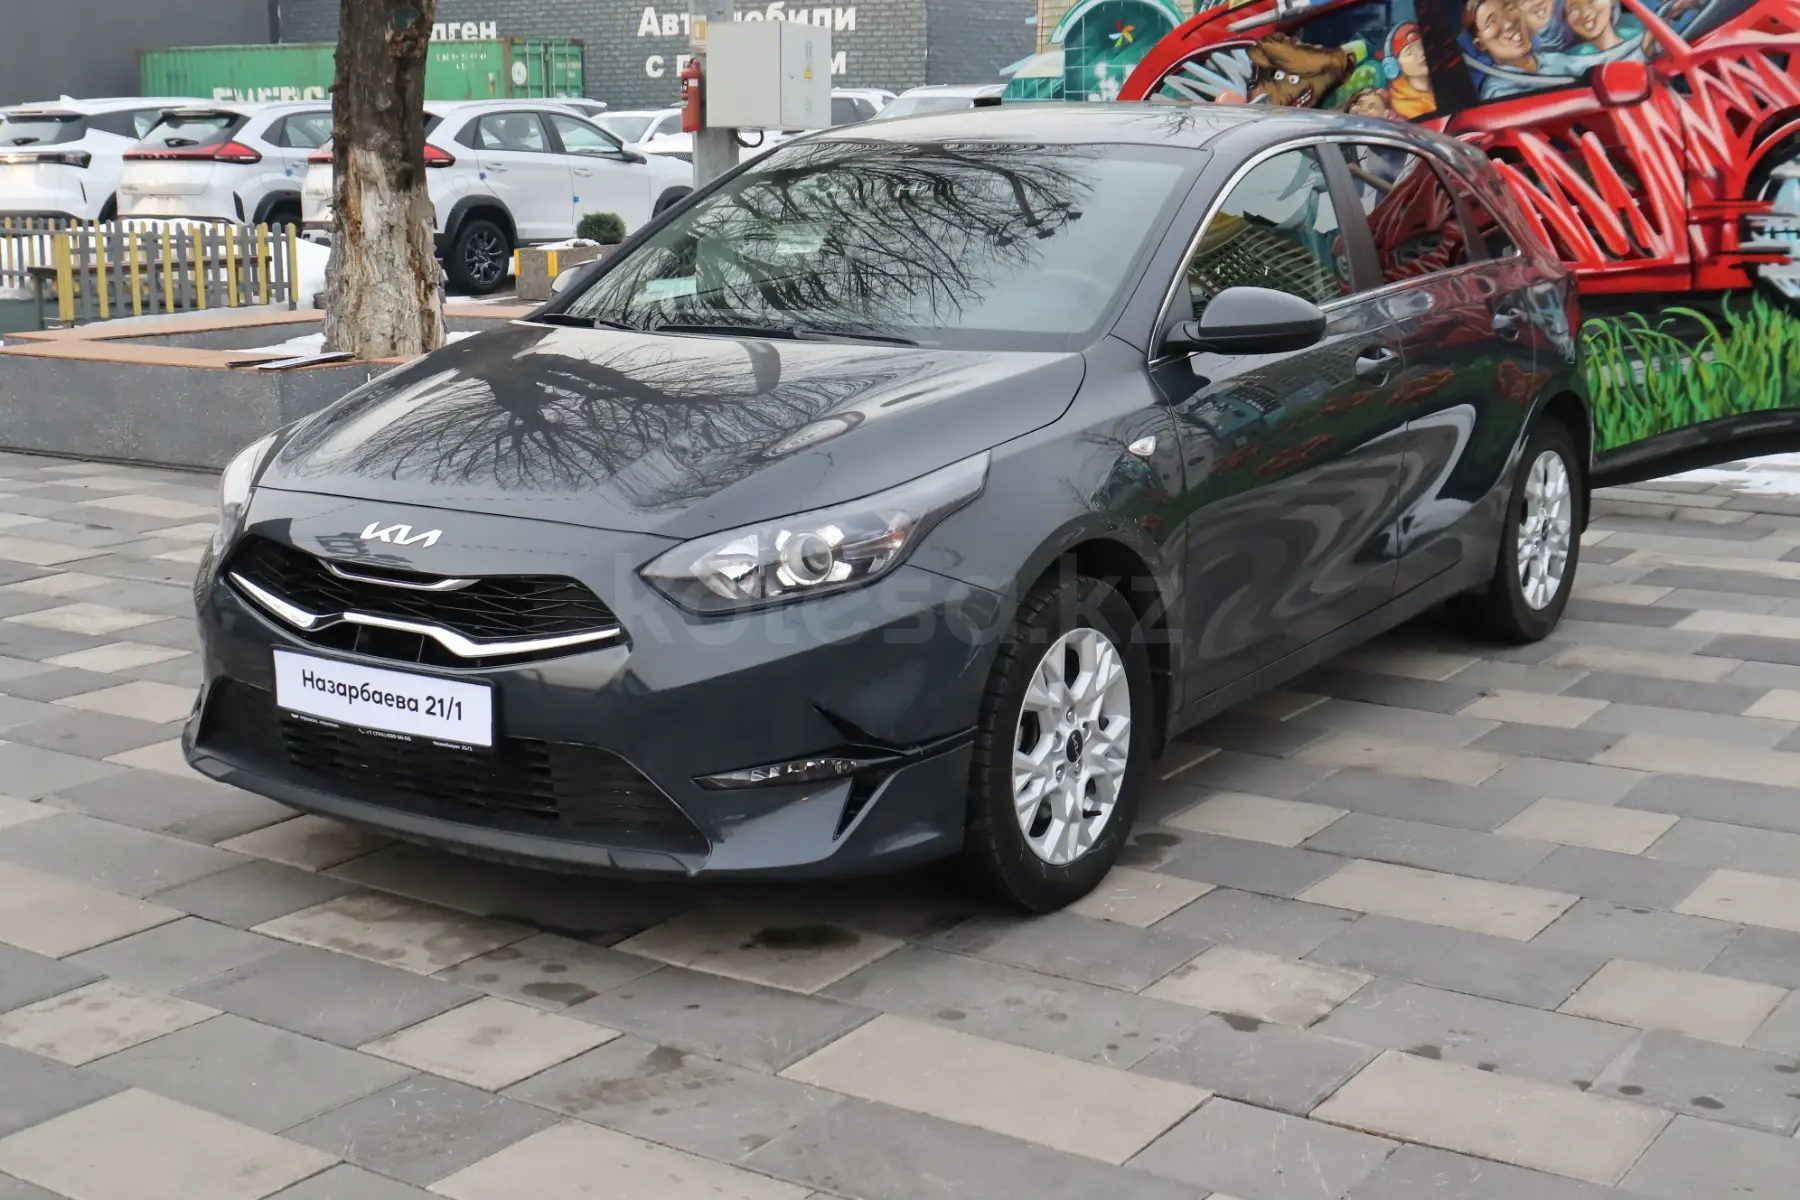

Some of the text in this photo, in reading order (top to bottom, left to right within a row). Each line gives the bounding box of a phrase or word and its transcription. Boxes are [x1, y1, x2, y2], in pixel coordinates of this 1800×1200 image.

[359, 521, 443, 549] KIA
[301, 668, 463, 721] Назарбаева 21/1
